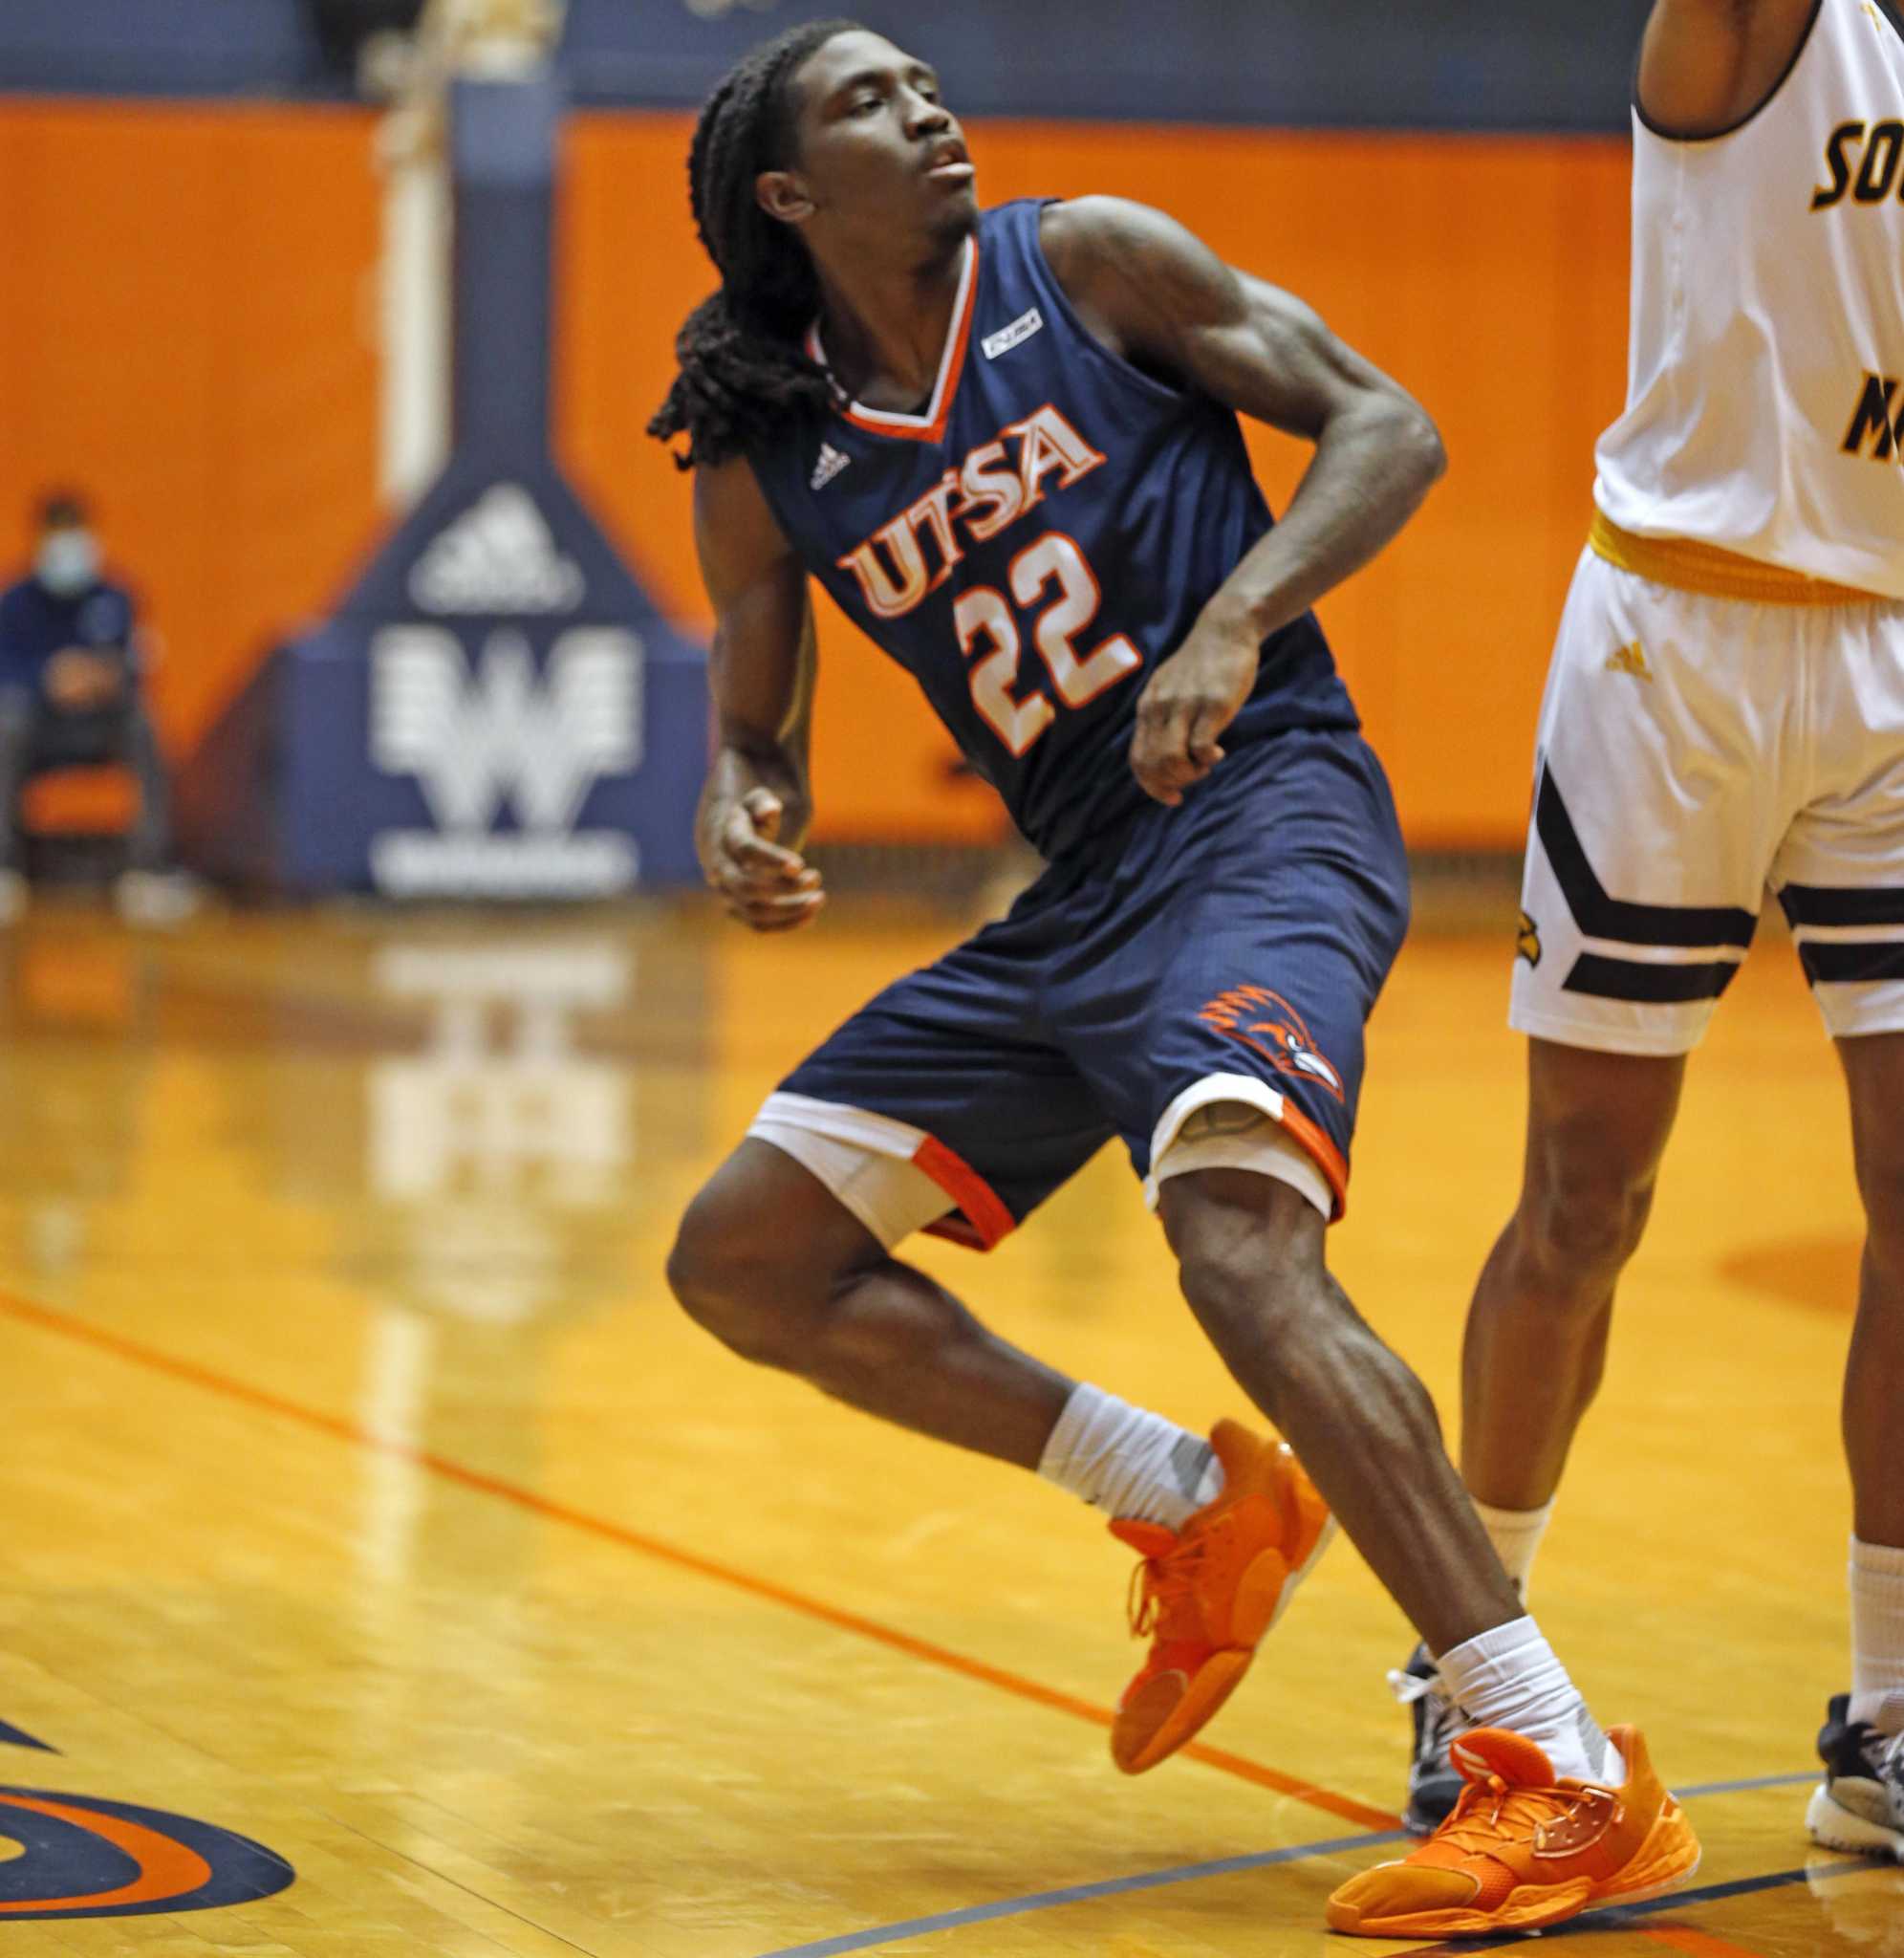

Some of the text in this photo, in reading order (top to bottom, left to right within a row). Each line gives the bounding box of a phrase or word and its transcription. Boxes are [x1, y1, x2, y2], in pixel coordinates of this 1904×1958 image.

[1809, 119, 1904, 213] SO
[836, 403, 1107, 618] UTSA
[954, 531, 1143, 758] 22
